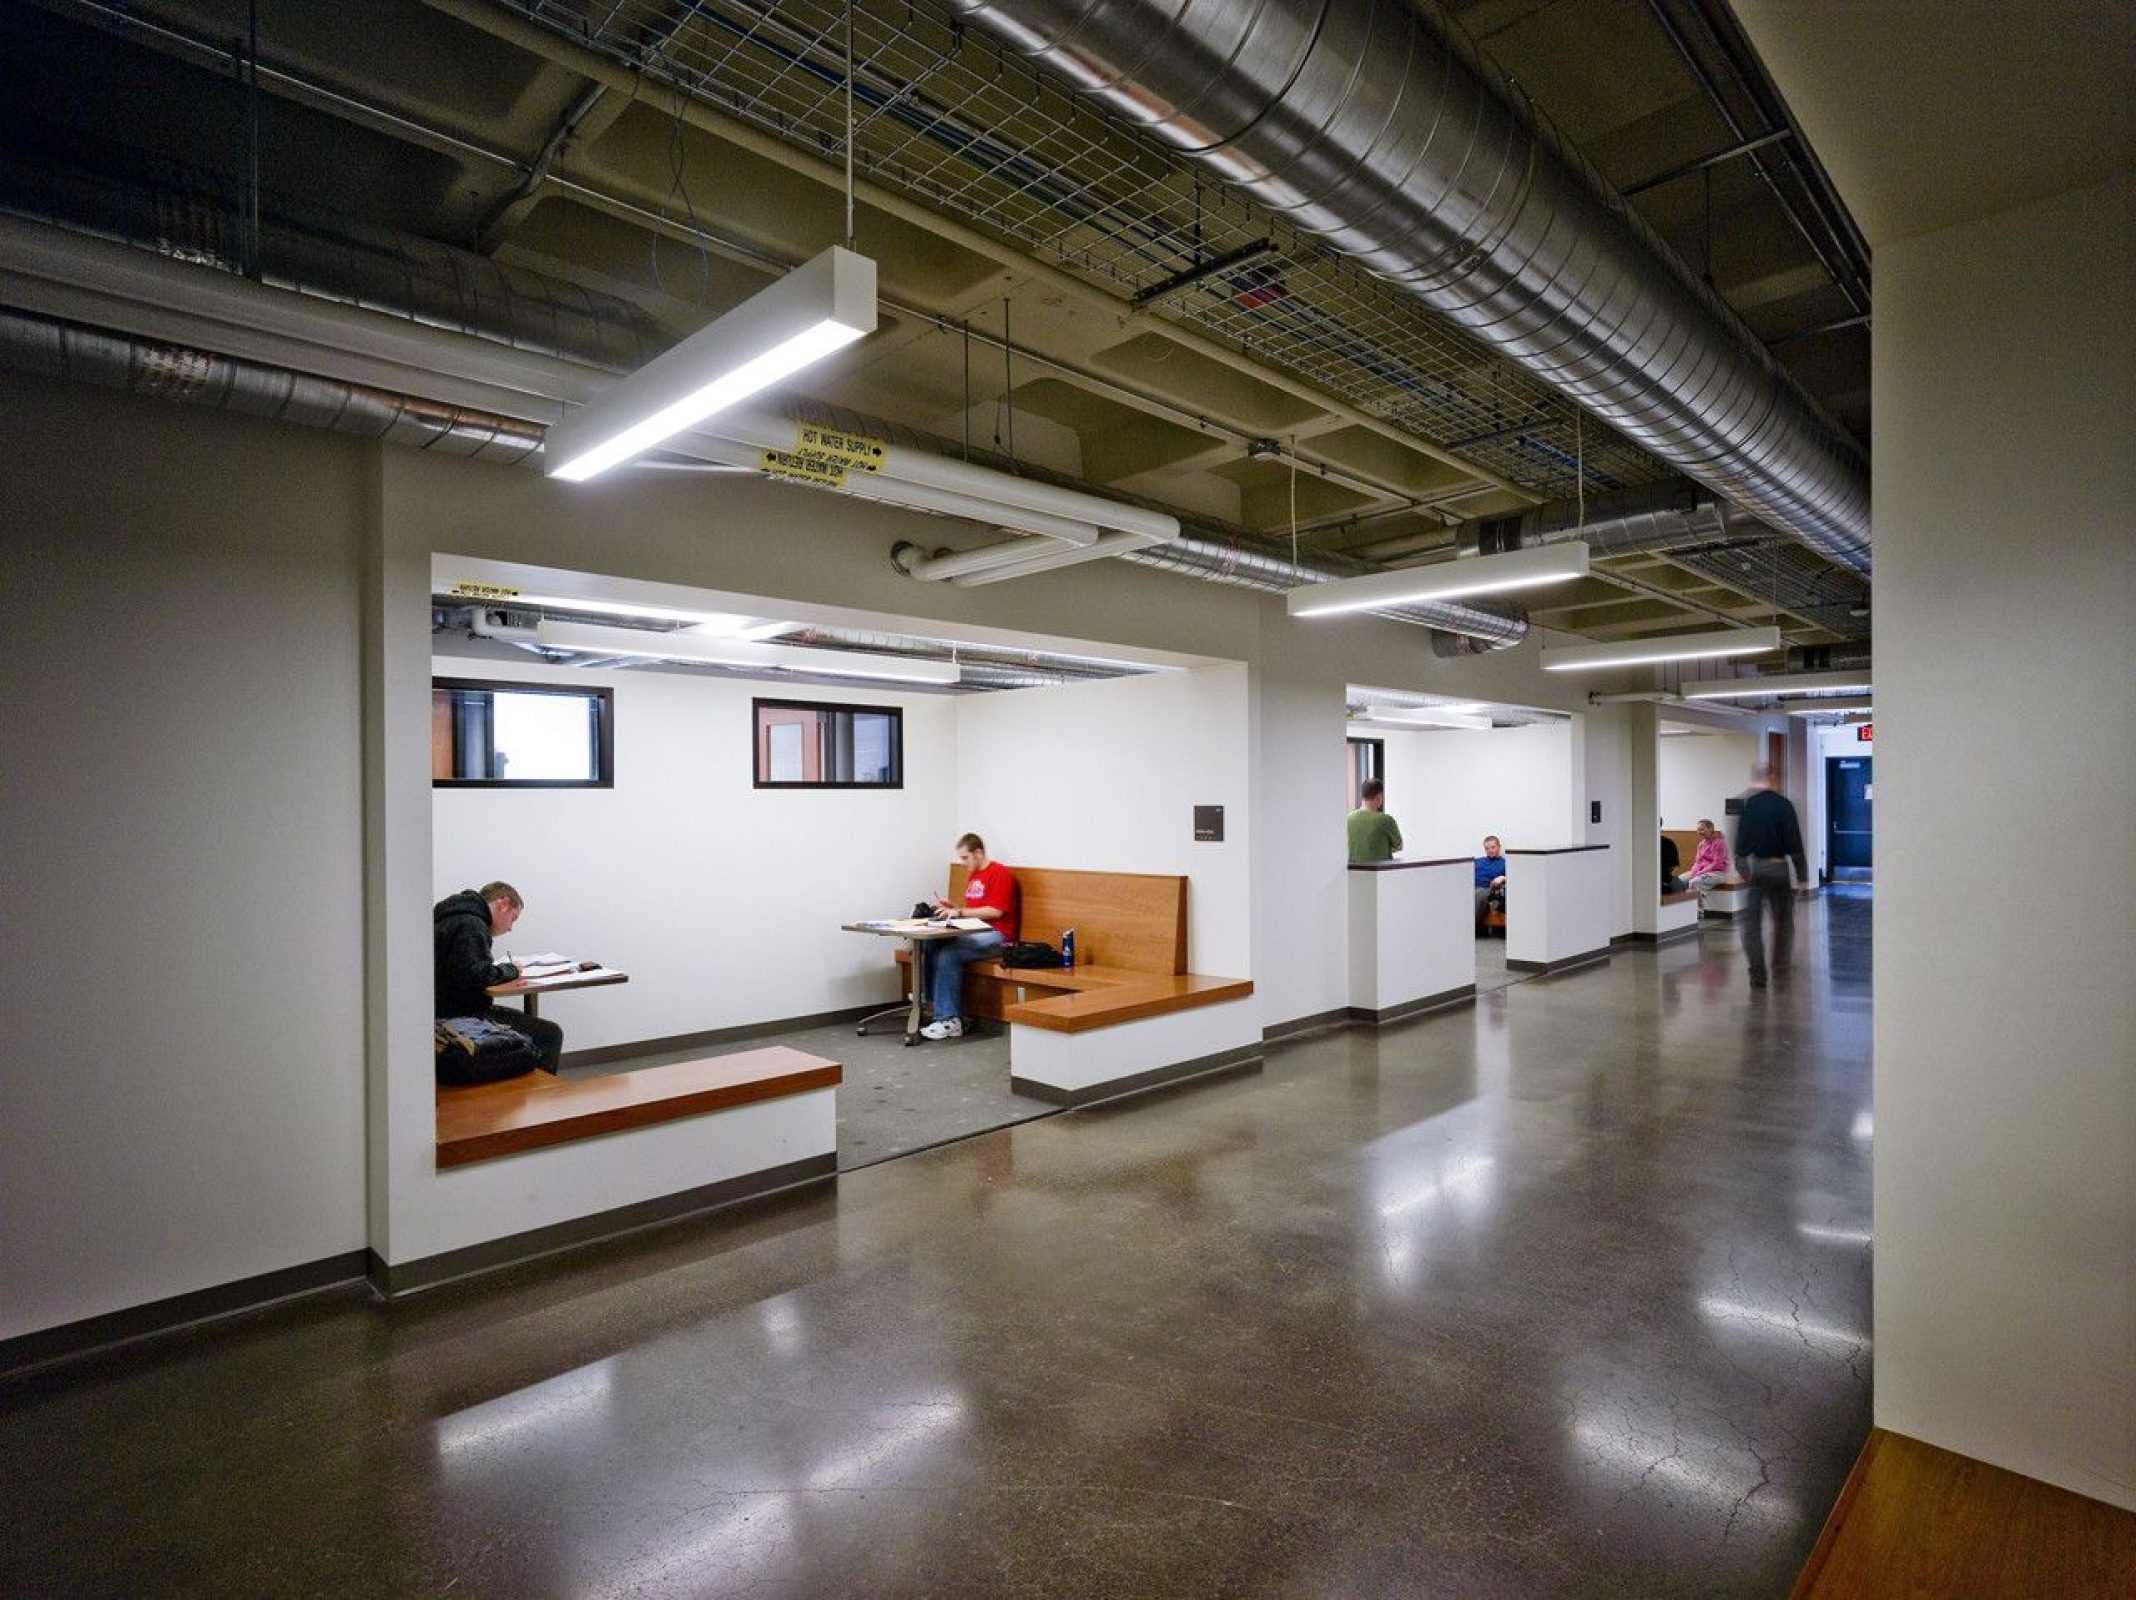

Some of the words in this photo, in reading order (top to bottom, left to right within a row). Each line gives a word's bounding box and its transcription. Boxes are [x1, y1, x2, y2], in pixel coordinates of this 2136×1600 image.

[803, 430, 818, 444] HOT
[820, 433, 844, 450] WATER
[846, 438, 872, 456] SUPPLY
